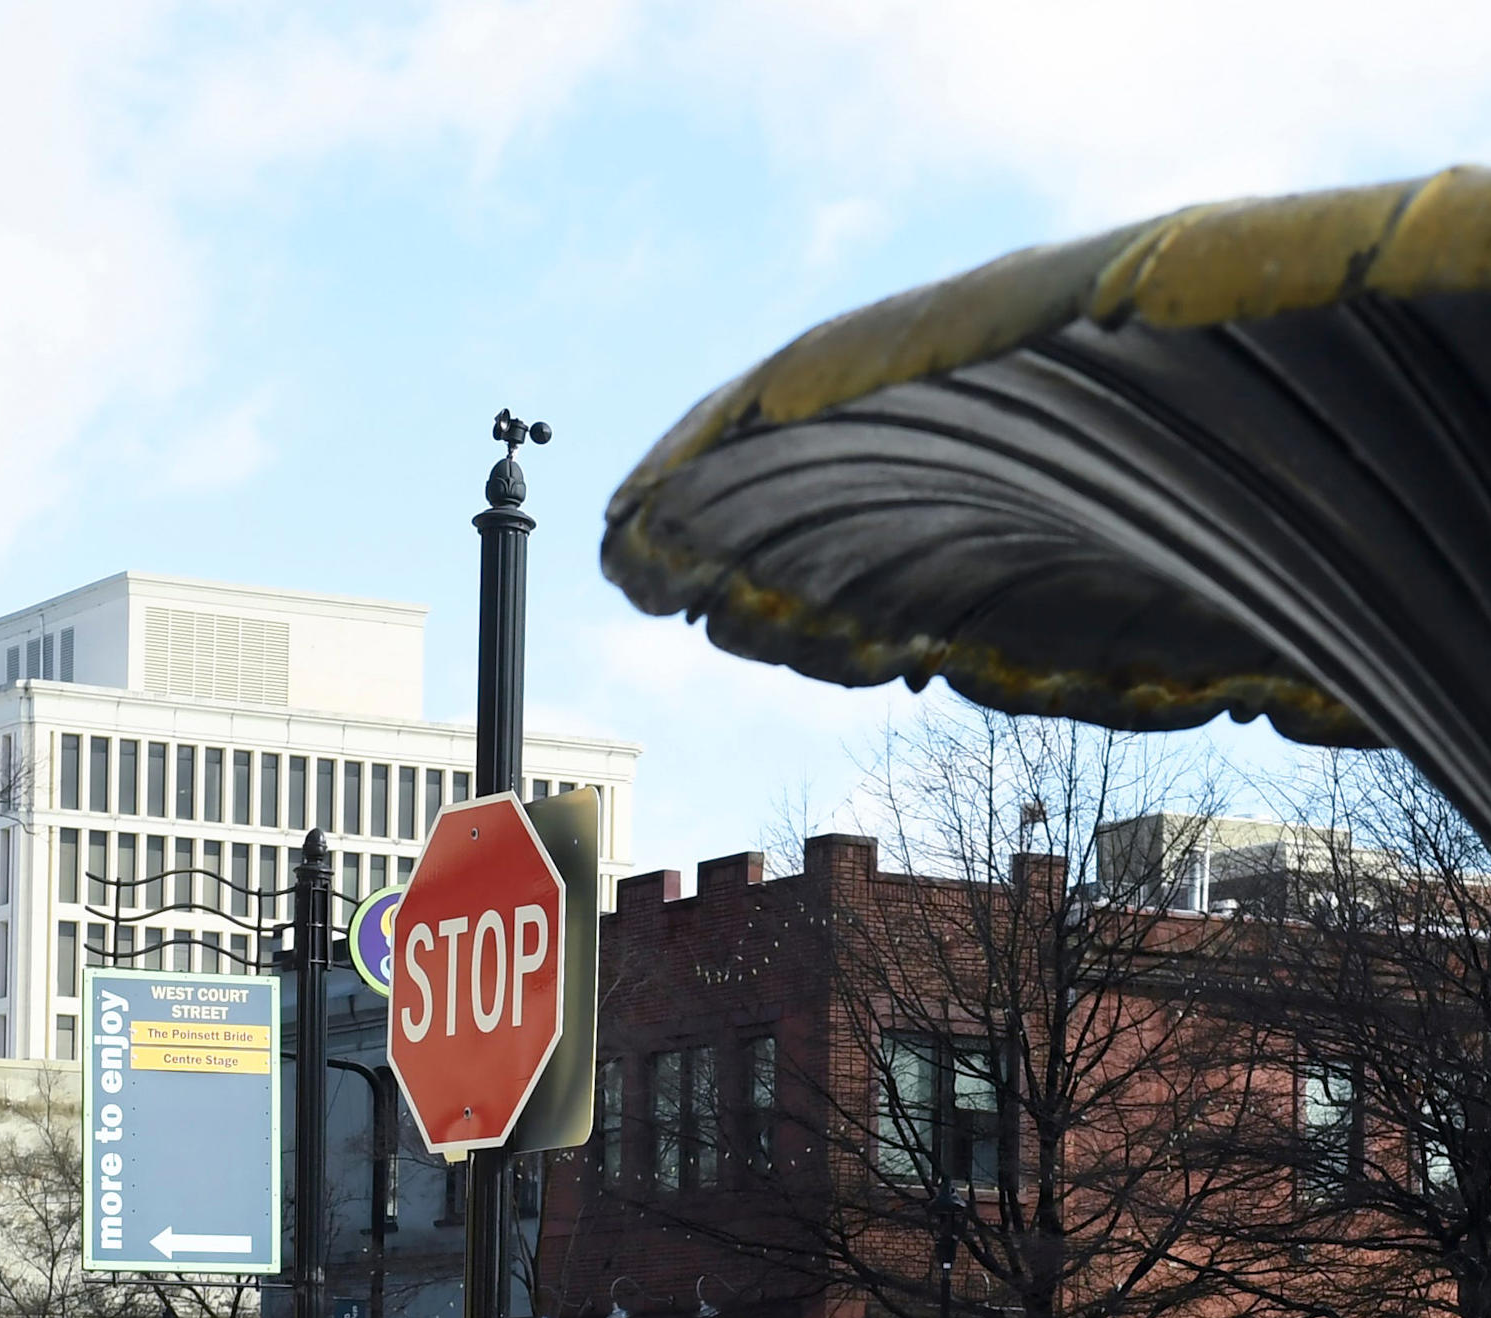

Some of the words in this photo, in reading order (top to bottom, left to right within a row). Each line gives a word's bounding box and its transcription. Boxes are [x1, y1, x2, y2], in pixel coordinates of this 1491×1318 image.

[401, 904, 549, 1043] STOP
[151, 985, 195, 1001] WEST
[197, 988, 250, 1003] COURT
[171, 1004, 229, 1020] STREET
[94, 989, 130, 1094] enjoy
[148, 1028, 168, 1039] The
[172, 1028, 220, 1041] Poinsett
[224, 1031, 254, 1042] Bride
[163, 1053, 202, 1065] Centre
[205, 1055, 239, 1068] Stage
[94, 1103, 123, 1144] to
[100, 1152, 123, 1250] more
